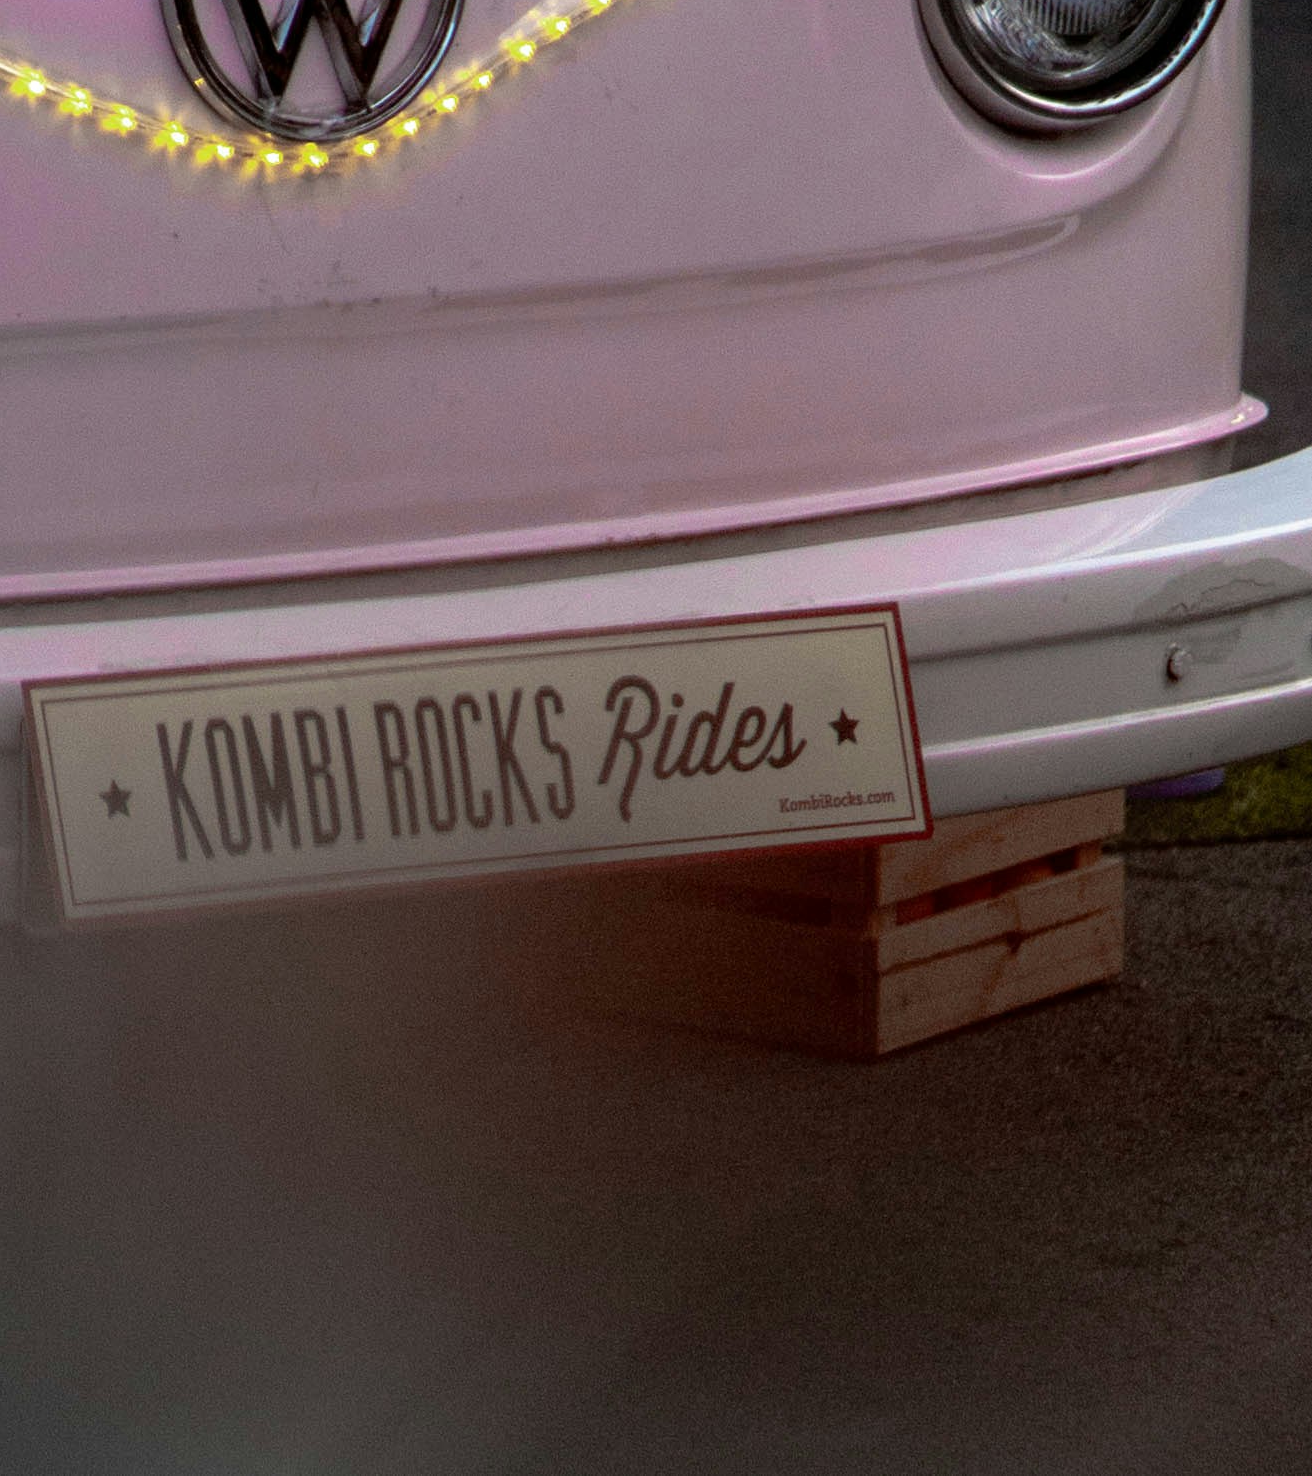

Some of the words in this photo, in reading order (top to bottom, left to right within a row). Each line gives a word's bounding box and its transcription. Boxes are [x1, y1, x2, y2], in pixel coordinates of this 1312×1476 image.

[156, 703, 365, 863] KOMBI
[375, 683, 575, 839] ROCKS
[596, 673, 807, 823] Rides
[778, 791, 896, 813] KombiRocks.com
